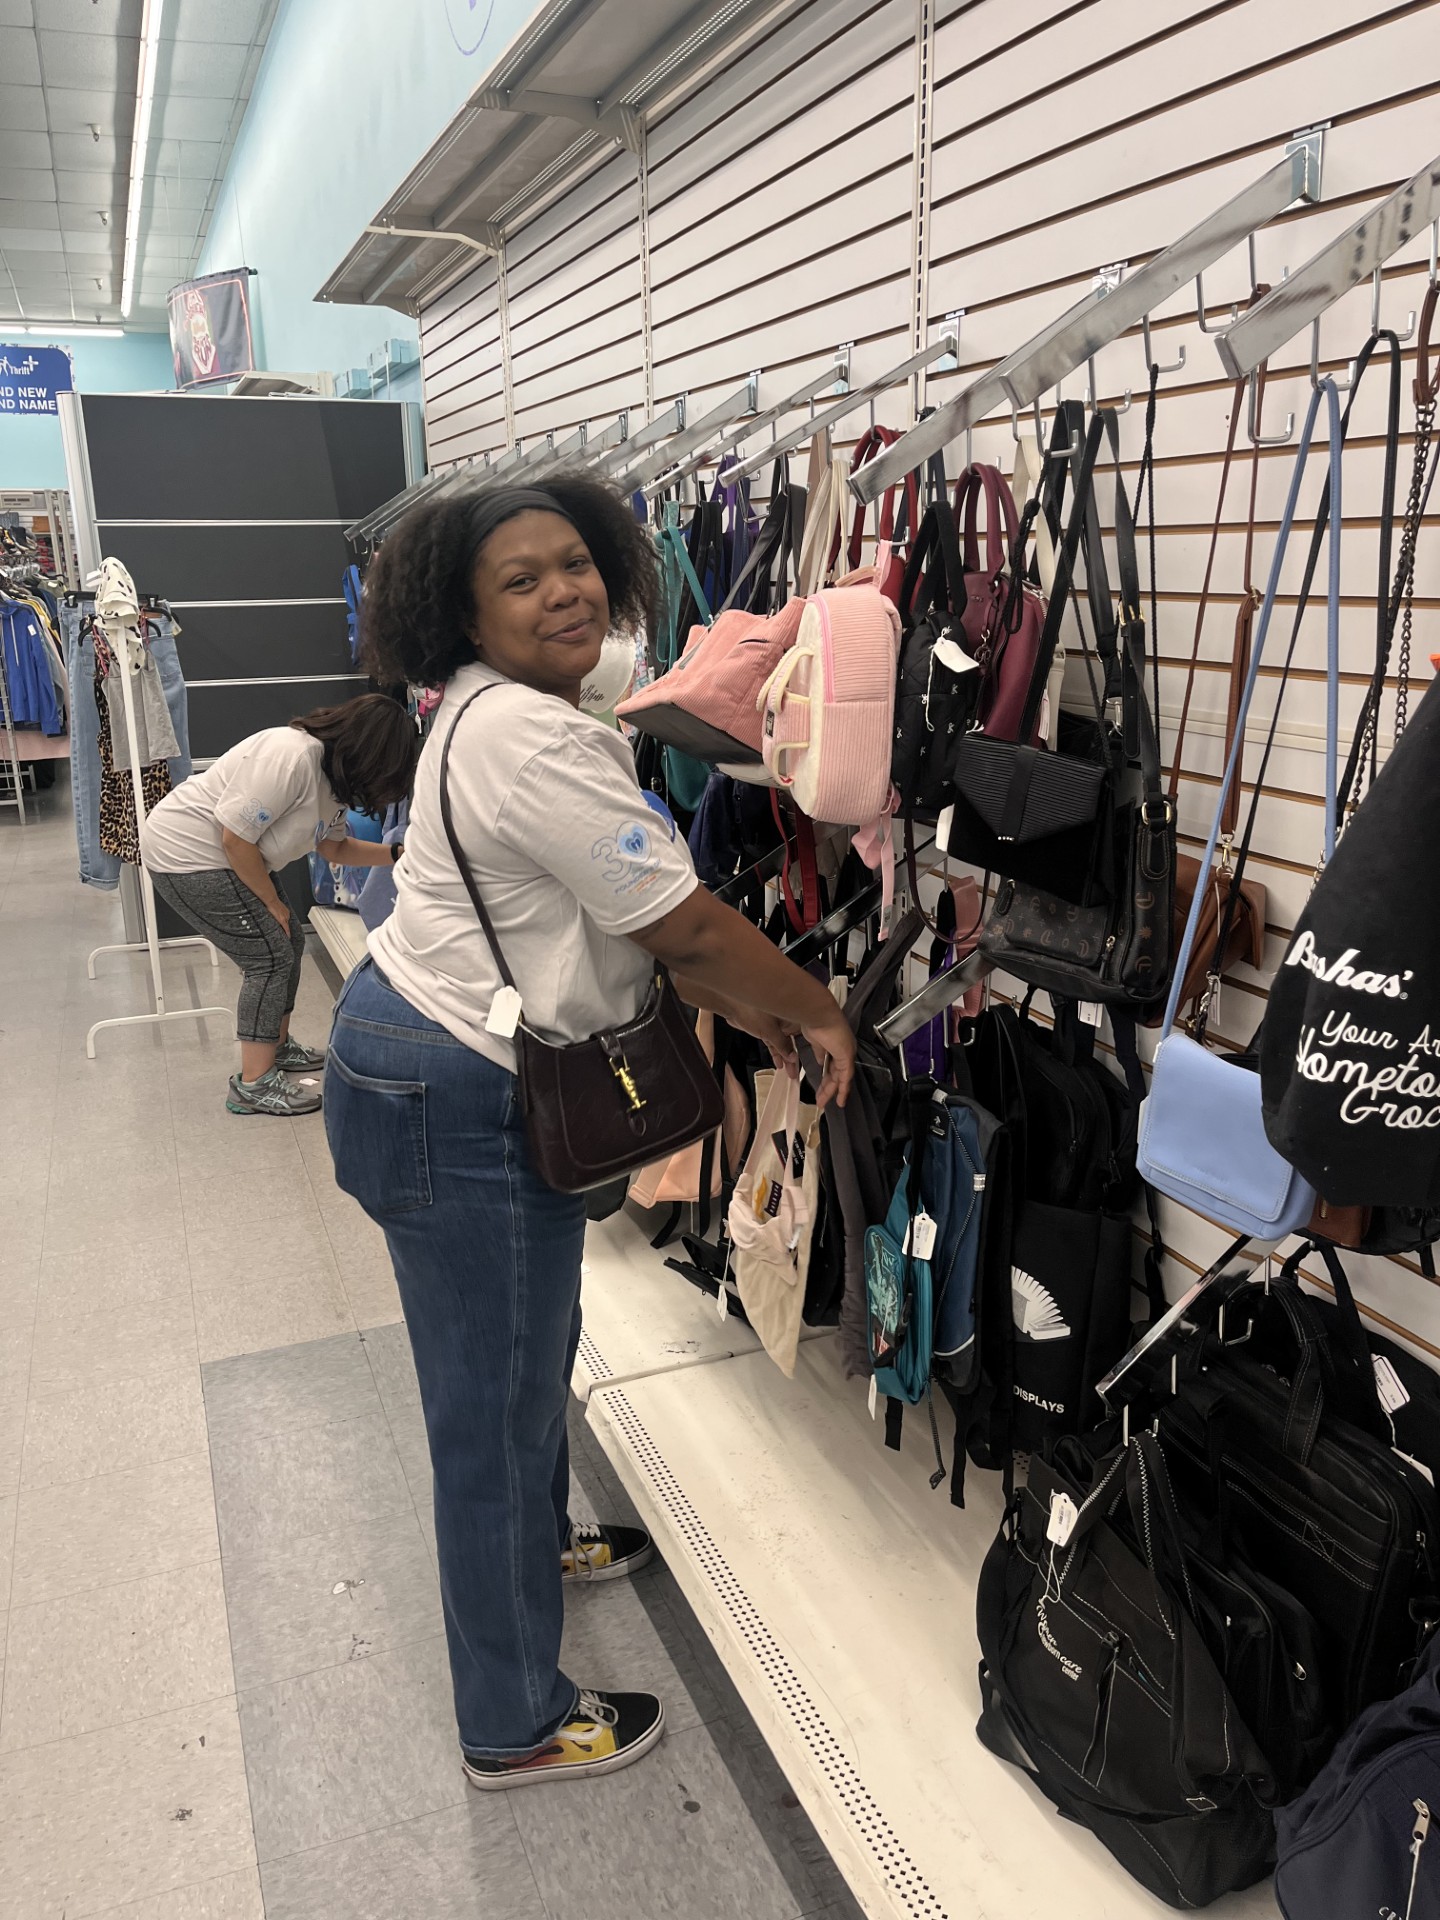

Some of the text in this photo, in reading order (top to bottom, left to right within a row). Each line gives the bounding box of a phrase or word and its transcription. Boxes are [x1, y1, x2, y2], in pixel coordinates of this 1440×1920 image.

[18, 387, 47, 398] NEW
[19, 399, 57, 410] NAME
[1318, 1009, 1399, 1050] Your
[1013, 1384, 1066, 1414] DISPLAYS
[1059, 1655, 1083, 1674] care
